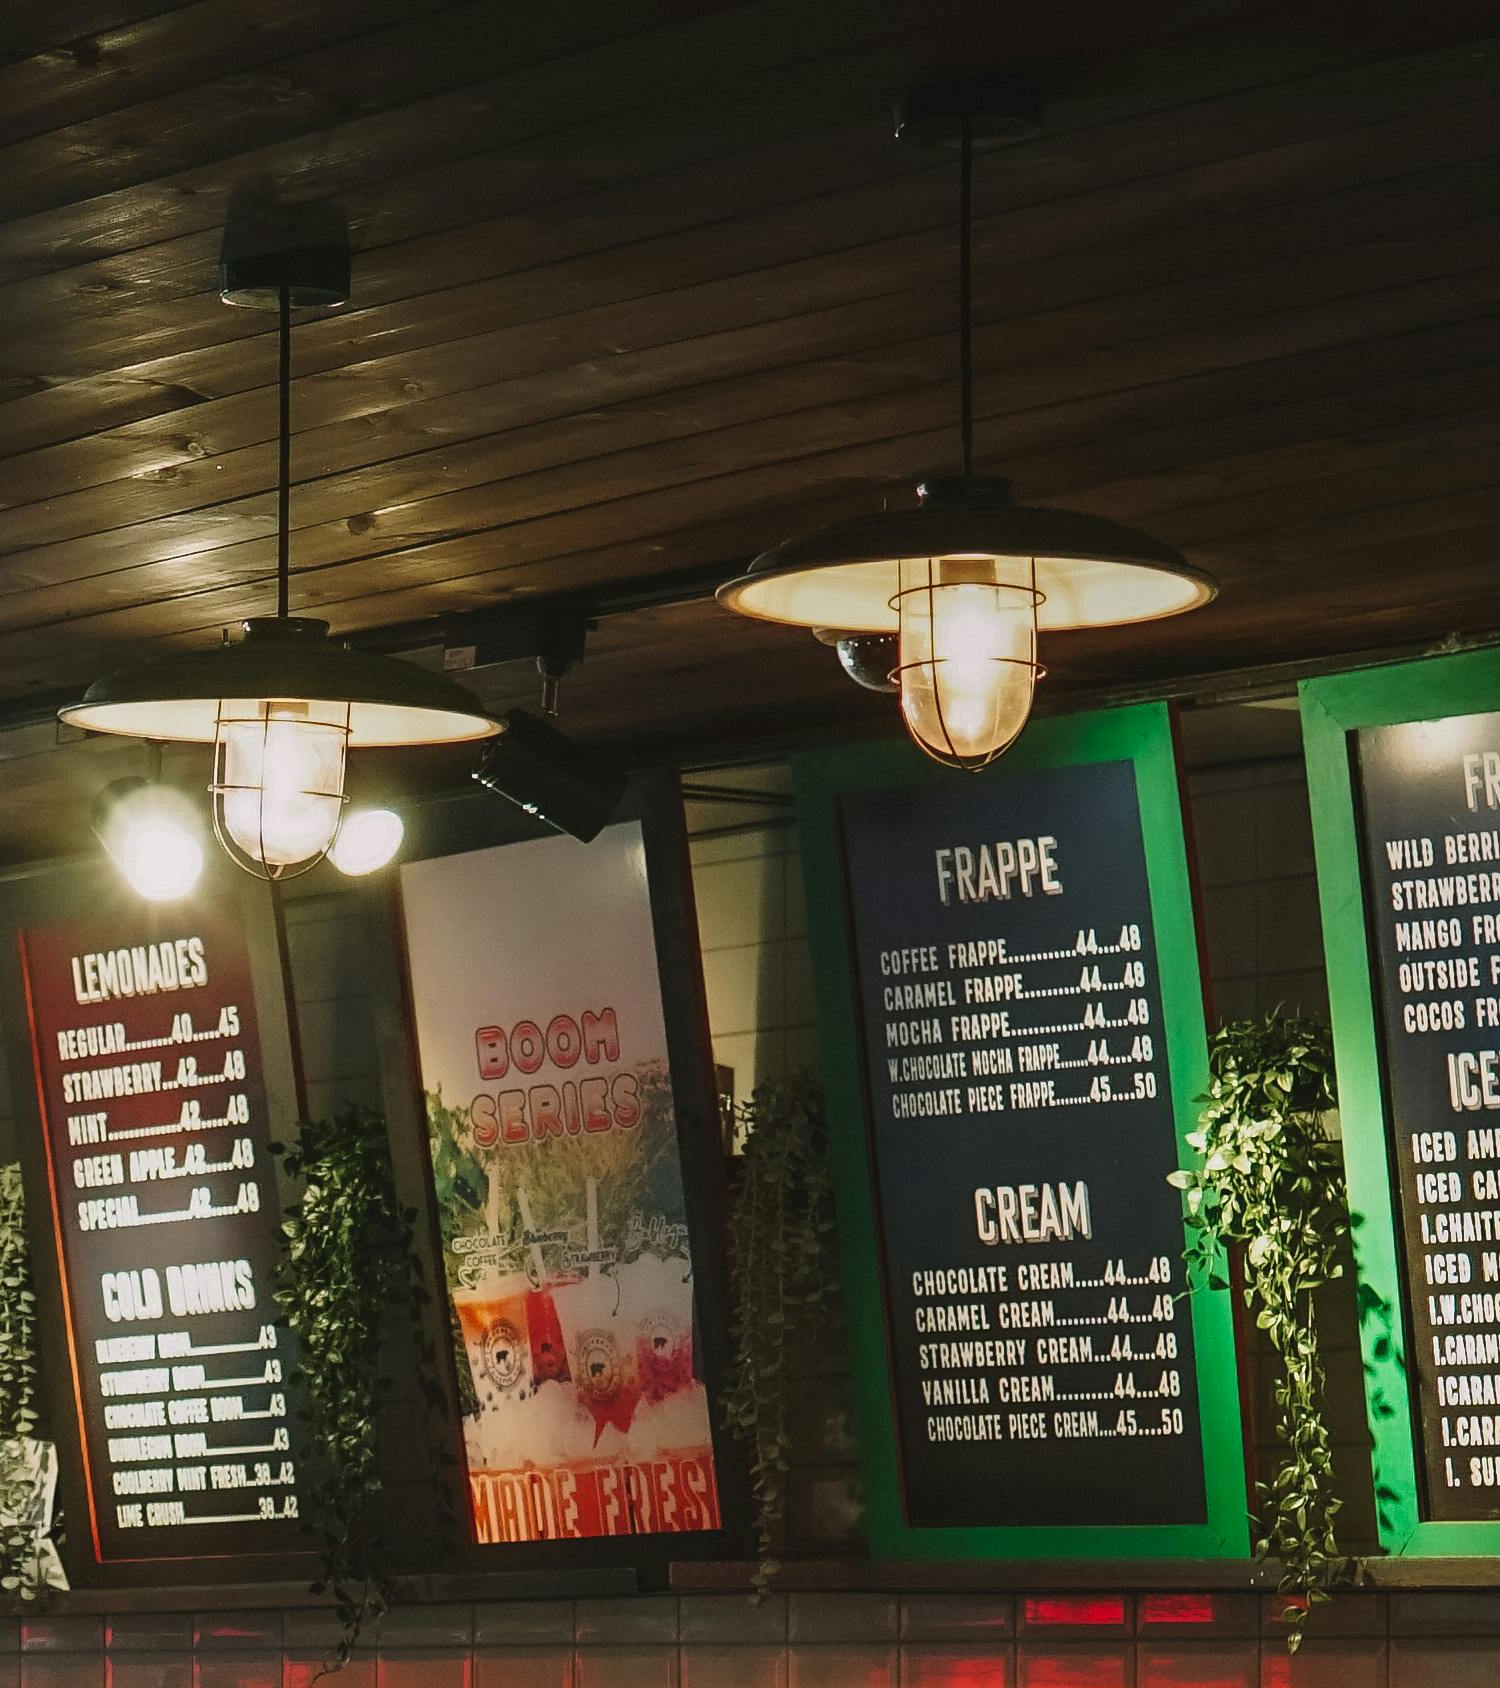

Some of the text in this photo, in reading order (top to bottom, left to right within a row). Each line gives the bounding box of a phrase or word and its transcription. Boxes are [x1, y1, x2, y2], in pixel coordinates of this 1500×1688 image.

[935, 836, 1063, 905] FRAPPE
[1386, 840, 1433, 870] WILD
[1395, 917, 1462, 951] MANGO
[72, 937, 208, 1004] LEMONADES
[881, 939, 1007, 976] COFFEE FRAPPE
[1399, 957, 1480, 993] OUTSIDE
[884, 974, 1024, 1011] CARAMEL FRAPPE
[57, 1006, 240, 1060] REGULAR 40 45
[886, 1012, 1011, 1047] MOCHA FRAPPE
[1404, 1000, 1465, 1033] COCOS
[474, 1007, 621, 1080] BOOM
[888, 1043, 1061, 1082] W.CHOCOLATE MOCHA FRAPPE
[63, 1061, 162, 1103] STRAWBERRY
[892, 1073, 1157, 1118] CHOCOLATE PIECE FRAPPE 45 50
[470, 1073, 642, 1147] SERIES
[68, 1112, 108, 1146] MINT
[1412, 1132, 1456, 1164] ICED
[73, 1147, 175, 1188] GREEN APPLE
[1416, 1172, 1462, 1203] ICED
[78, 1196, 140, 1231] SPECIAL
[974, 1181, 1093, 1245] CREAM
[913, 1263, 1074, 1296] CHOCOLATE CREAM
[1425, 1253, 1471, 1285] ICED
[102, 1260, 256, 1322] COLD DRINKS
[915, 1300, 1054, 1333] CARAMEL CREAM
[920, 1336, 1093, 1370] STRAWBERRY CREAM
[922, 1375, 1055, 1406] VANILLA CREAM
[927, 1410, 1099, 1442] CHOCOLATE PIECE CREAM
[116, 1501, 184, 1528] LIME CRUSH
[470, 1469, 581, 1544] MADE
